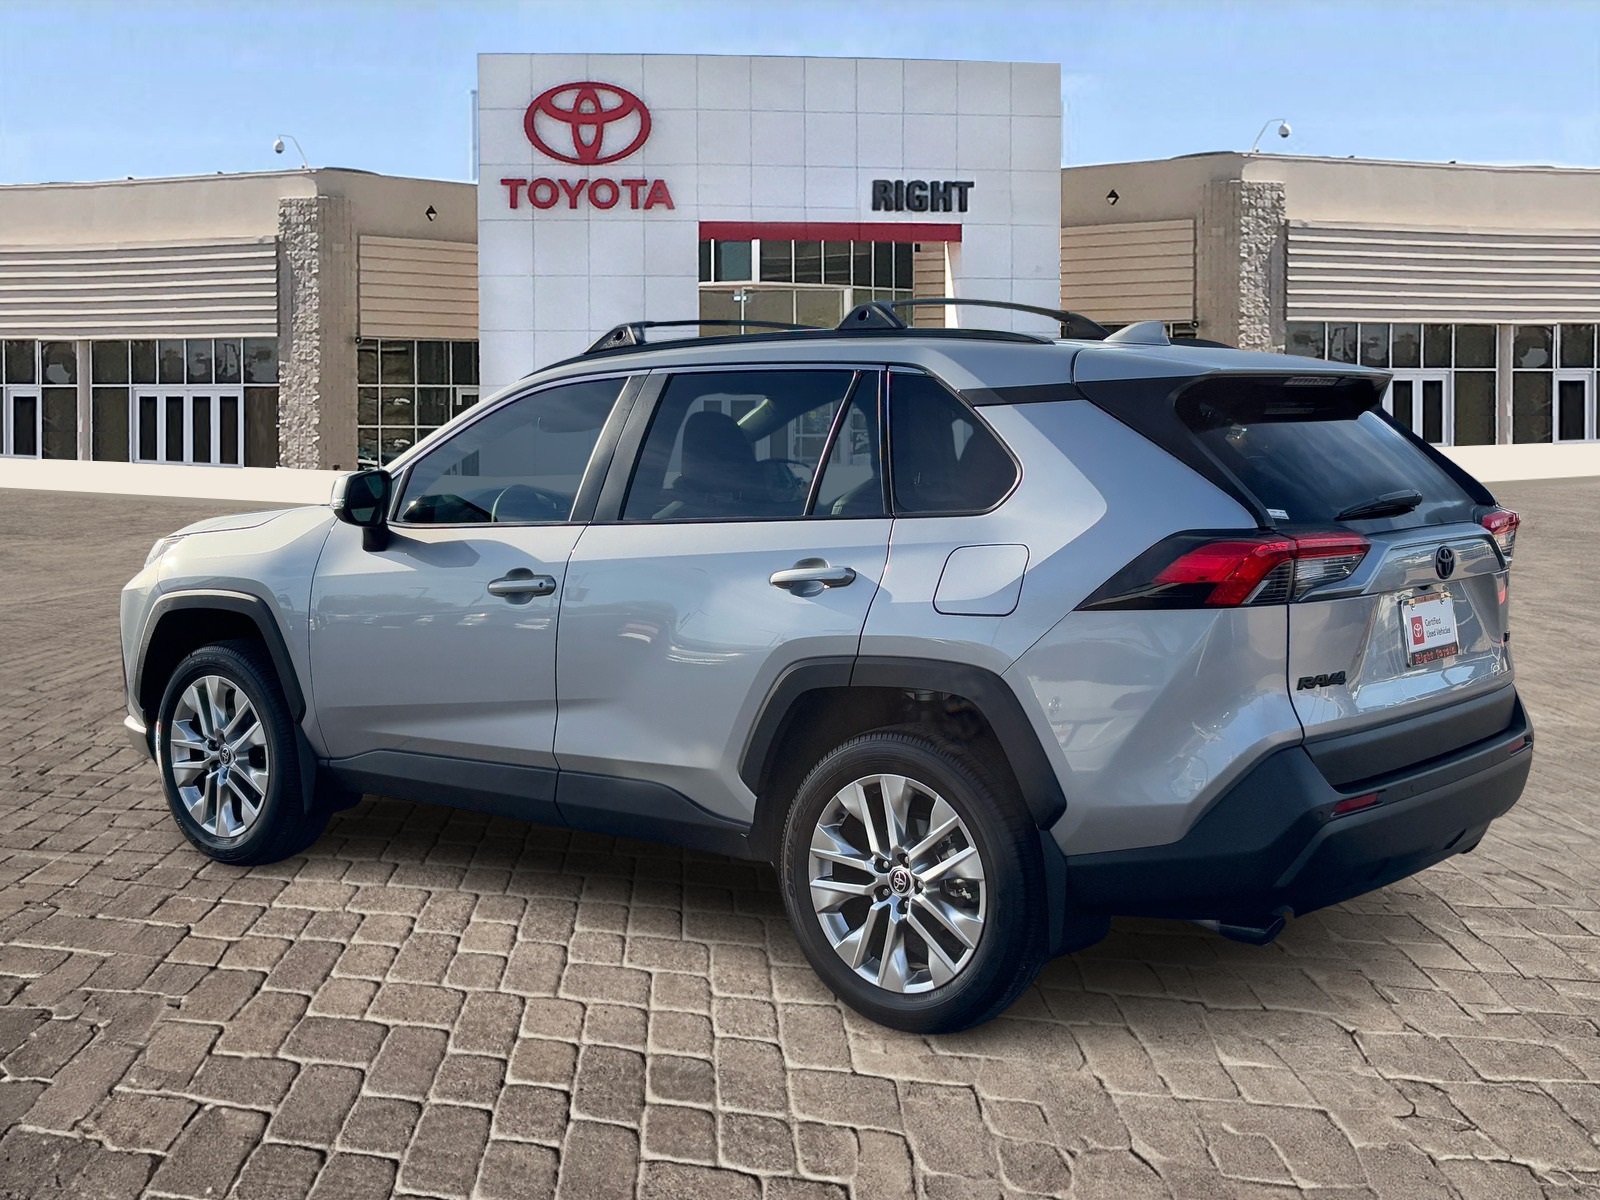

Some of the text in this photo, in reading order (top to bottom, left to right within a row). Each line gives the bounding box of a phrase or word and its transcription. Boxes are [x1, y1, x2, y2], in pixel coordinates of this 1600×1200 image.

[500, 177, 675, 210] TOYOTA
[872, 179, 975, 212] RIGHT
[1425, 616, 1441, 626] Certified
[1436, 626, 1451, 636] Vehicles
[1297, 670, 1346, 690] RAV4
